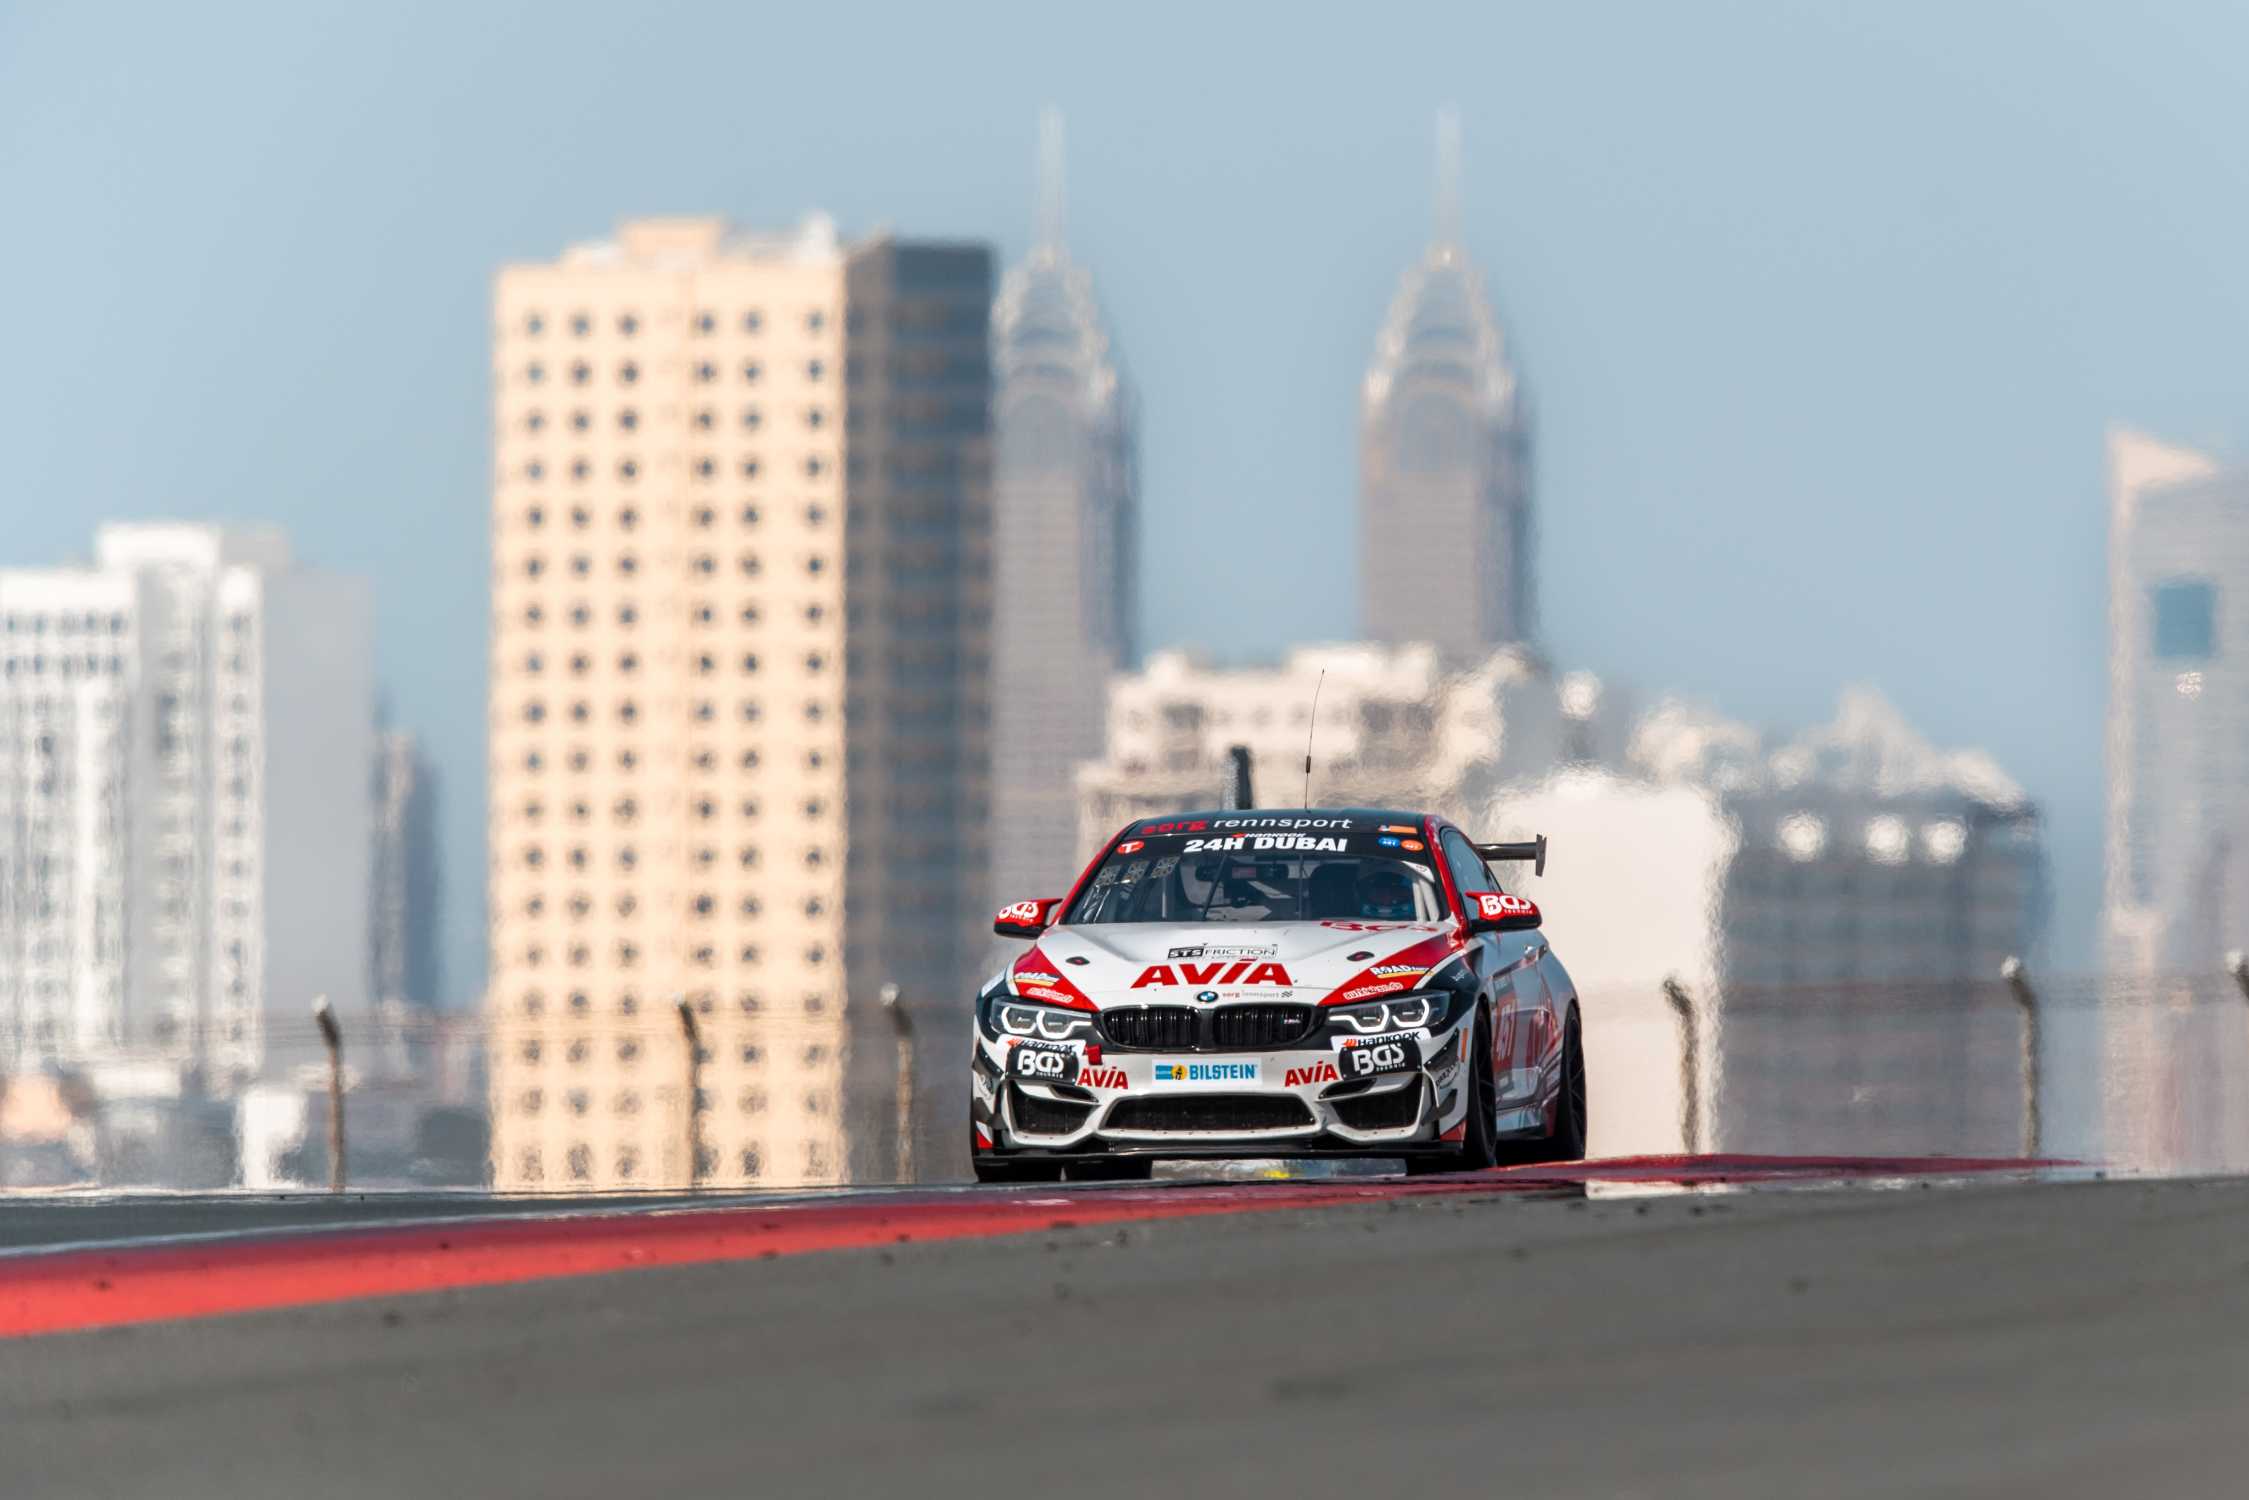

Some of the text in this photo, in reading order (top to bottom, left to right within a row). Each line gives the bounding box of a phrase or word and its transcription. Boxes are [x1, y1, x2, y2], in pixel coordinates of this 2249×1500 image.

[1213, 818, 1353, 829] rennsport
[1184, 837, 1348, 853] 24H DUBAI
[1480, 895, 1531, 915] BGS
[1130, 958, 1293, 989] AVIA
[1017, 1049, 1065, 1076] BGS
[1351, 1043, 1405, 1075] BGS
[1076, 1066, 1129, 1090] AVIA
[1189, 1064, 1256, 1080] BILSTEIN
[1284, 1061, 1338, 1088] AVIA
